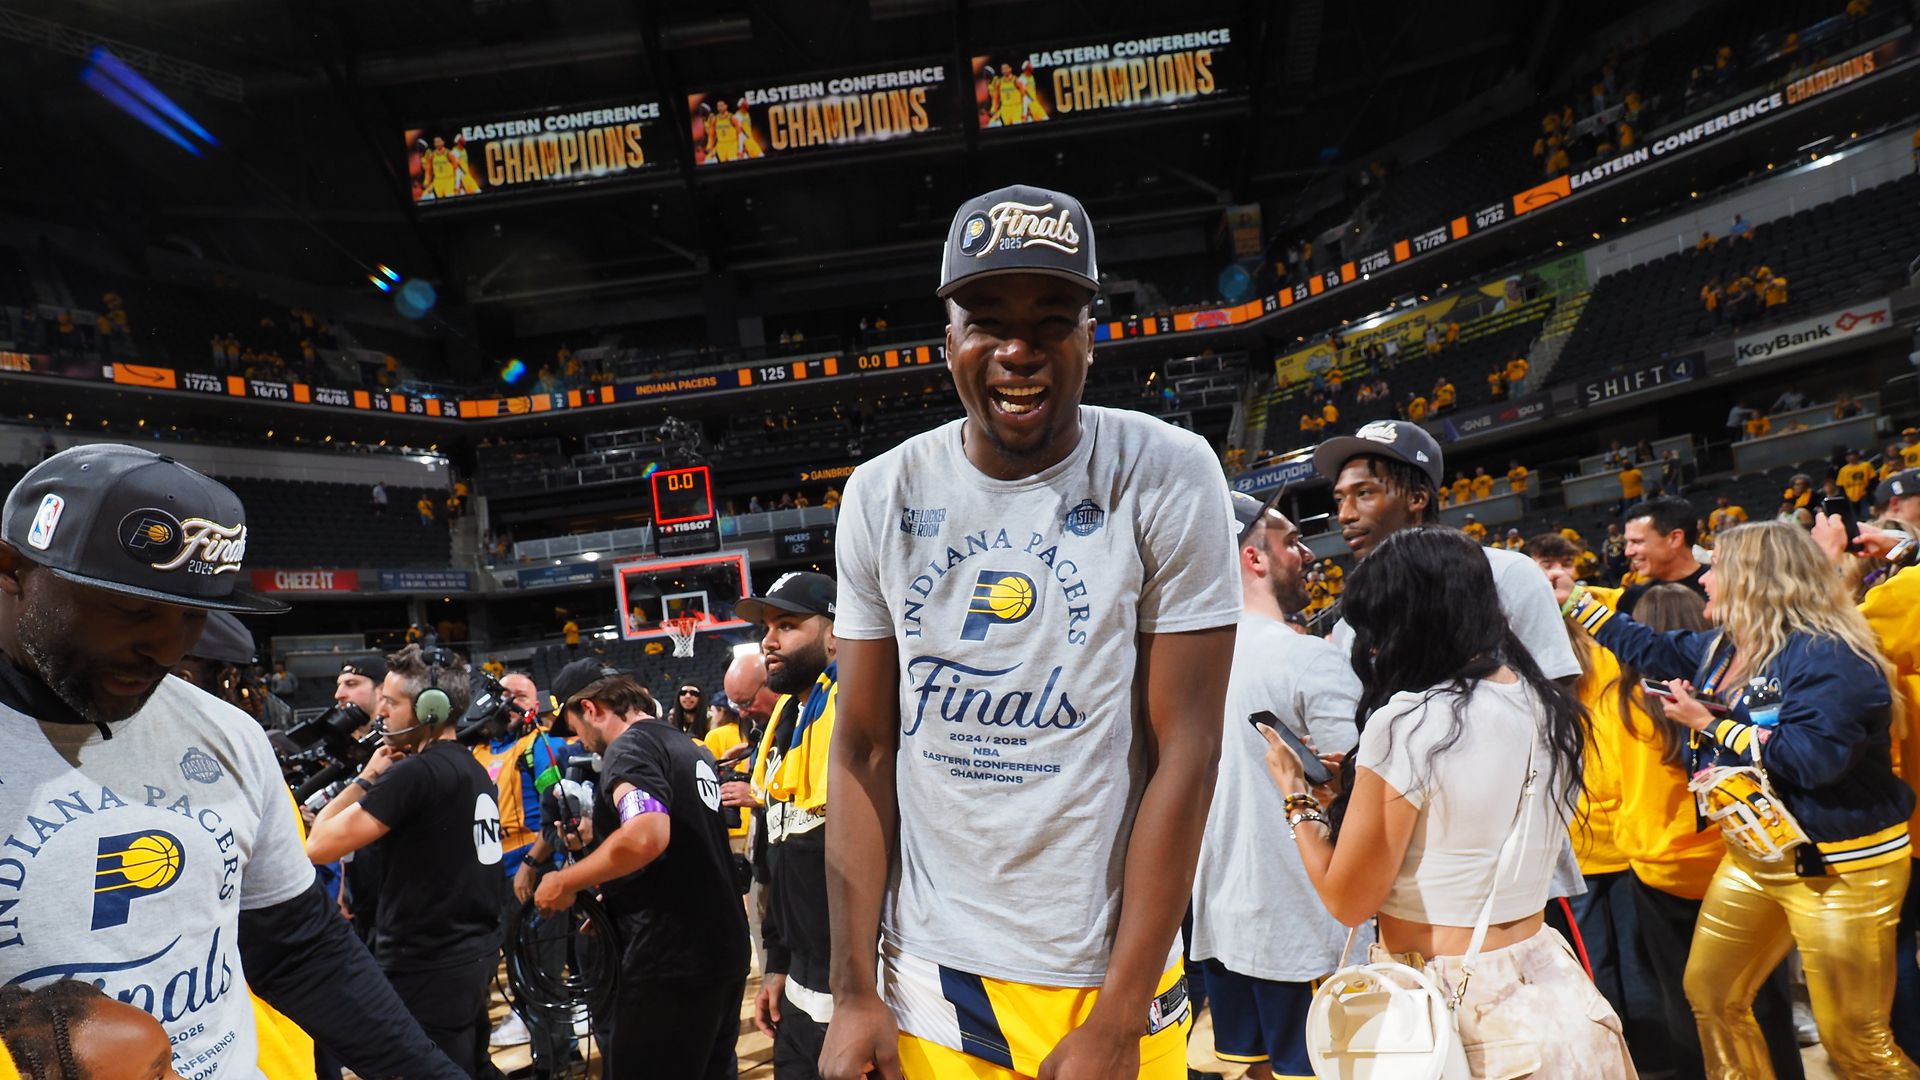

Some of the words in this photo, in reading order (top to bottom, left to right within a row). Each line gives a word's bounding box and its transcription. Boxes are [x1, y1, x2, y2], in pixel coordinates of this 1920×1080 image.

[1029, 44, 1109, 69] EASTERN
[1113, 28, 1231, 58] CONFERENCE
[744, 81, 825, 106] EASTERN
[827, 66, 945, 95] CONFERENCE
[1053, 49, 1215, 113] CHAMPIONS
[461, 118, 541, 142] EASTERN
[544, 102, 660, 131] CONFERENCE
[767, 87, 929, 151] CHAMPIONS
[1570, 147, 1649, 190] EASTERN
[1652, 93, 1783, 156] CONFERENCE
[1786, 51, 1876, 105] CHAMPIONS
[485, 123, 644, 187] CHAMPIONS
[1476, 209, 1505, 229] 9/32
[976, 201, 1080, 259] Finals
[1000, 237, 1024, 250] 2025
[1414, 232, 1448, 252] 17/26
[1737, 323, 1832, 361] KeyBank
[858, 354, 881, 369] 0.0
[760, 366, 786, 382] 125
[1586, 366, 1666, 402] SHIFT
[1675, 361, 1687, 376] 4
[184, 377, 222, 393] 17/33
[252, 385, 289, 400] 16/19
[635, 381, 677, 396] INDIANA
[679, 376, 718, 391] PACERS
[374, 399, 389, 410] 10
[668, 473, 694, 491] 0.0
[1256, 461, 1313, 486] HYUNDAI
[920, 507, 946, 523] LOCKER
[1067, 510, 1104, 527] EASTERN
[672, 520, 711, 532] TISSOT
[917, 523, 940, 537] ROOM
[784, 533, 811, 544] PACERS
[188, 559, 215, 575] 2025
[904, 528, 1013, 638] INDIANA
[1024, 531, 1090, 646] PACERS
[903, 655, 1084, 737] Finals
[949, 732, 983, 743] 2024
[993, 736, 1028, 747] 2025
[923, 750, 971, 767] EASTERN
[973, 759, 1062, 774] CONFERENCE
[972, 747, 1001, 758] NBA
[949, 768, 1025, 785] CHAMPIONS
[0, 786, 128, 948] INDIANA
[144, 784, 239, 901] PACERS
[169, 1022, 205, 1046] 2025
[174, 1030, 236, 1075] NFERENCE
